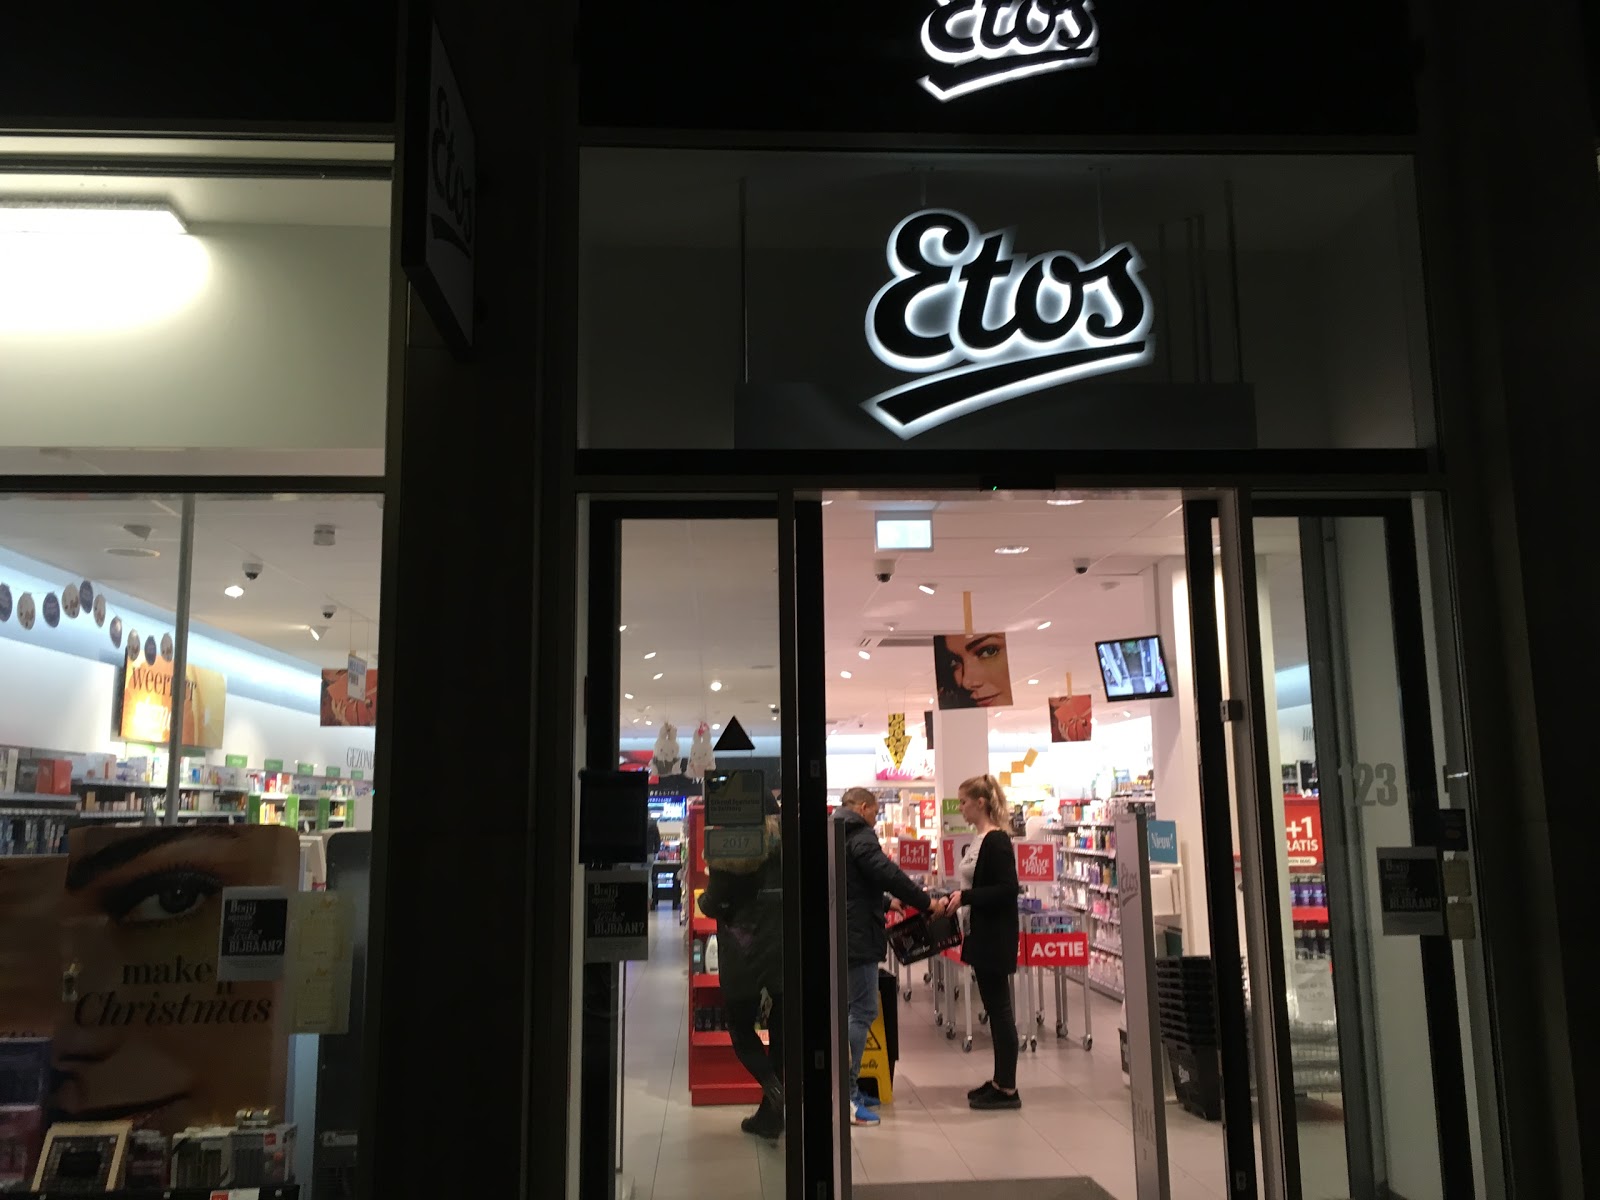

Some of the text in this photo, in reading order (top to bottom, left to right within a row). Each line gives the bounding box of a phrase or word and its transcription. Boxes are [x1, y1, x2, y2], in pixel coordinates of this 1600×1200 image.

[920, 0, 1098, 62] Etos
[432, 86, 472, 243] Etos
[866, 208, 1153, 371] Etos
[722, 838, 750, 849] 2017
[903, 843, 925, 857] 1+1
[900, 856, 928, 865] GRATIS
[1021, 859, 1050, 868] HALVE
[1025, 866, 1047, 876] PRIJS
[229, 939, 283, 953] BIJBAAN?
[1031, 941, 1085, 958] ACTIE
[122, 955, 213, 984] make
[74, 991, 272, 1027] Christmas
